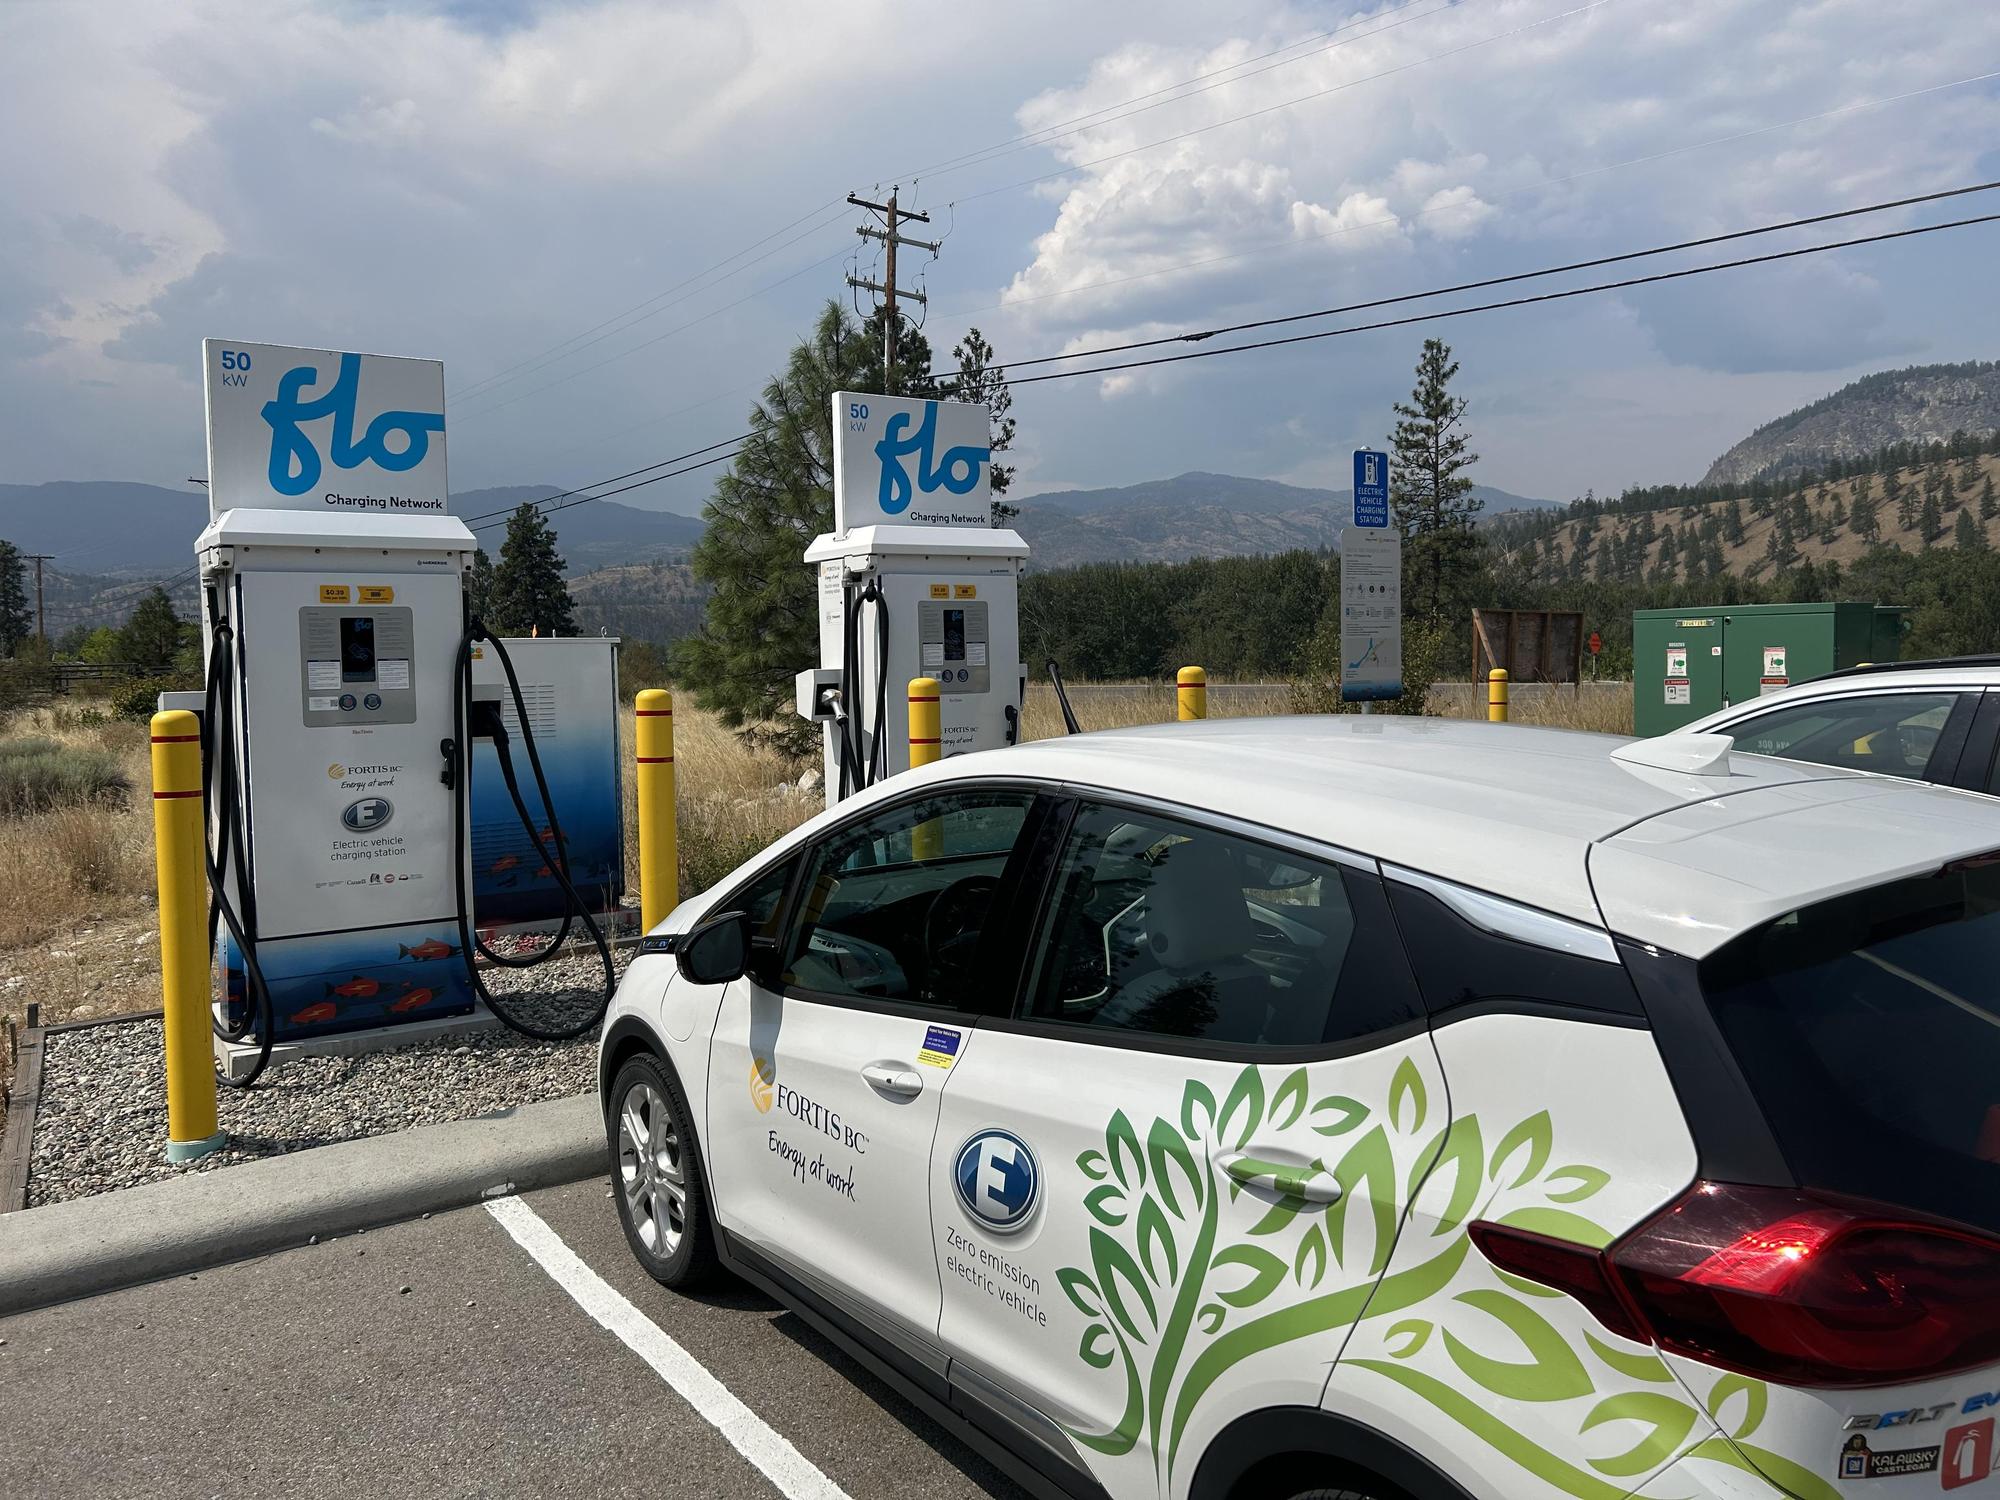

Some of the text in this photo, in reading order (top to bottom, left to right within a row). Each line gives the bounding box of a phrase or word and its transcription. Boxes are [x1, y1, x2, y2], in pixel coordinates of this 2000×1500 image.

[222, 351, 251, 371] 50
[223, 373, 247, 387] kW
[850, 404, 868, 419] 50
[261, 352, 445, 496] flo
[850, 422, 867, 432] kW
[874, 401, 990, 515] flo
[1358, 487, 1384, 496] ELECTRIC
[325, 493, 443, 509] Charging Network
[910, 511, 986, 523] Charging Network
[1356, 506, 1386, 514] CHARGING
[1359, 516, 1383, 524] STATION
[348, 766, 388, 774] FORTIS
[341, 776, 395, 791] Energy at work
[333, 836, 403, 850] Electric vehicle
[331, 847, 406, 861] charging station
[777, 1084, 867, 1154] FORTIS BC
[768, 1131, 856, 1202] Energy at work
[947, 1226, 1041, 1295] Zero emission
[947, 1256, 1047, 1327] electric vehicle
[1842, 1402, 1956, 1430] BOLT
[1871, 1450, 1938, 1467] KALAWSKY
[1876, 1462, 1931, 1474] CASTLEGAR
